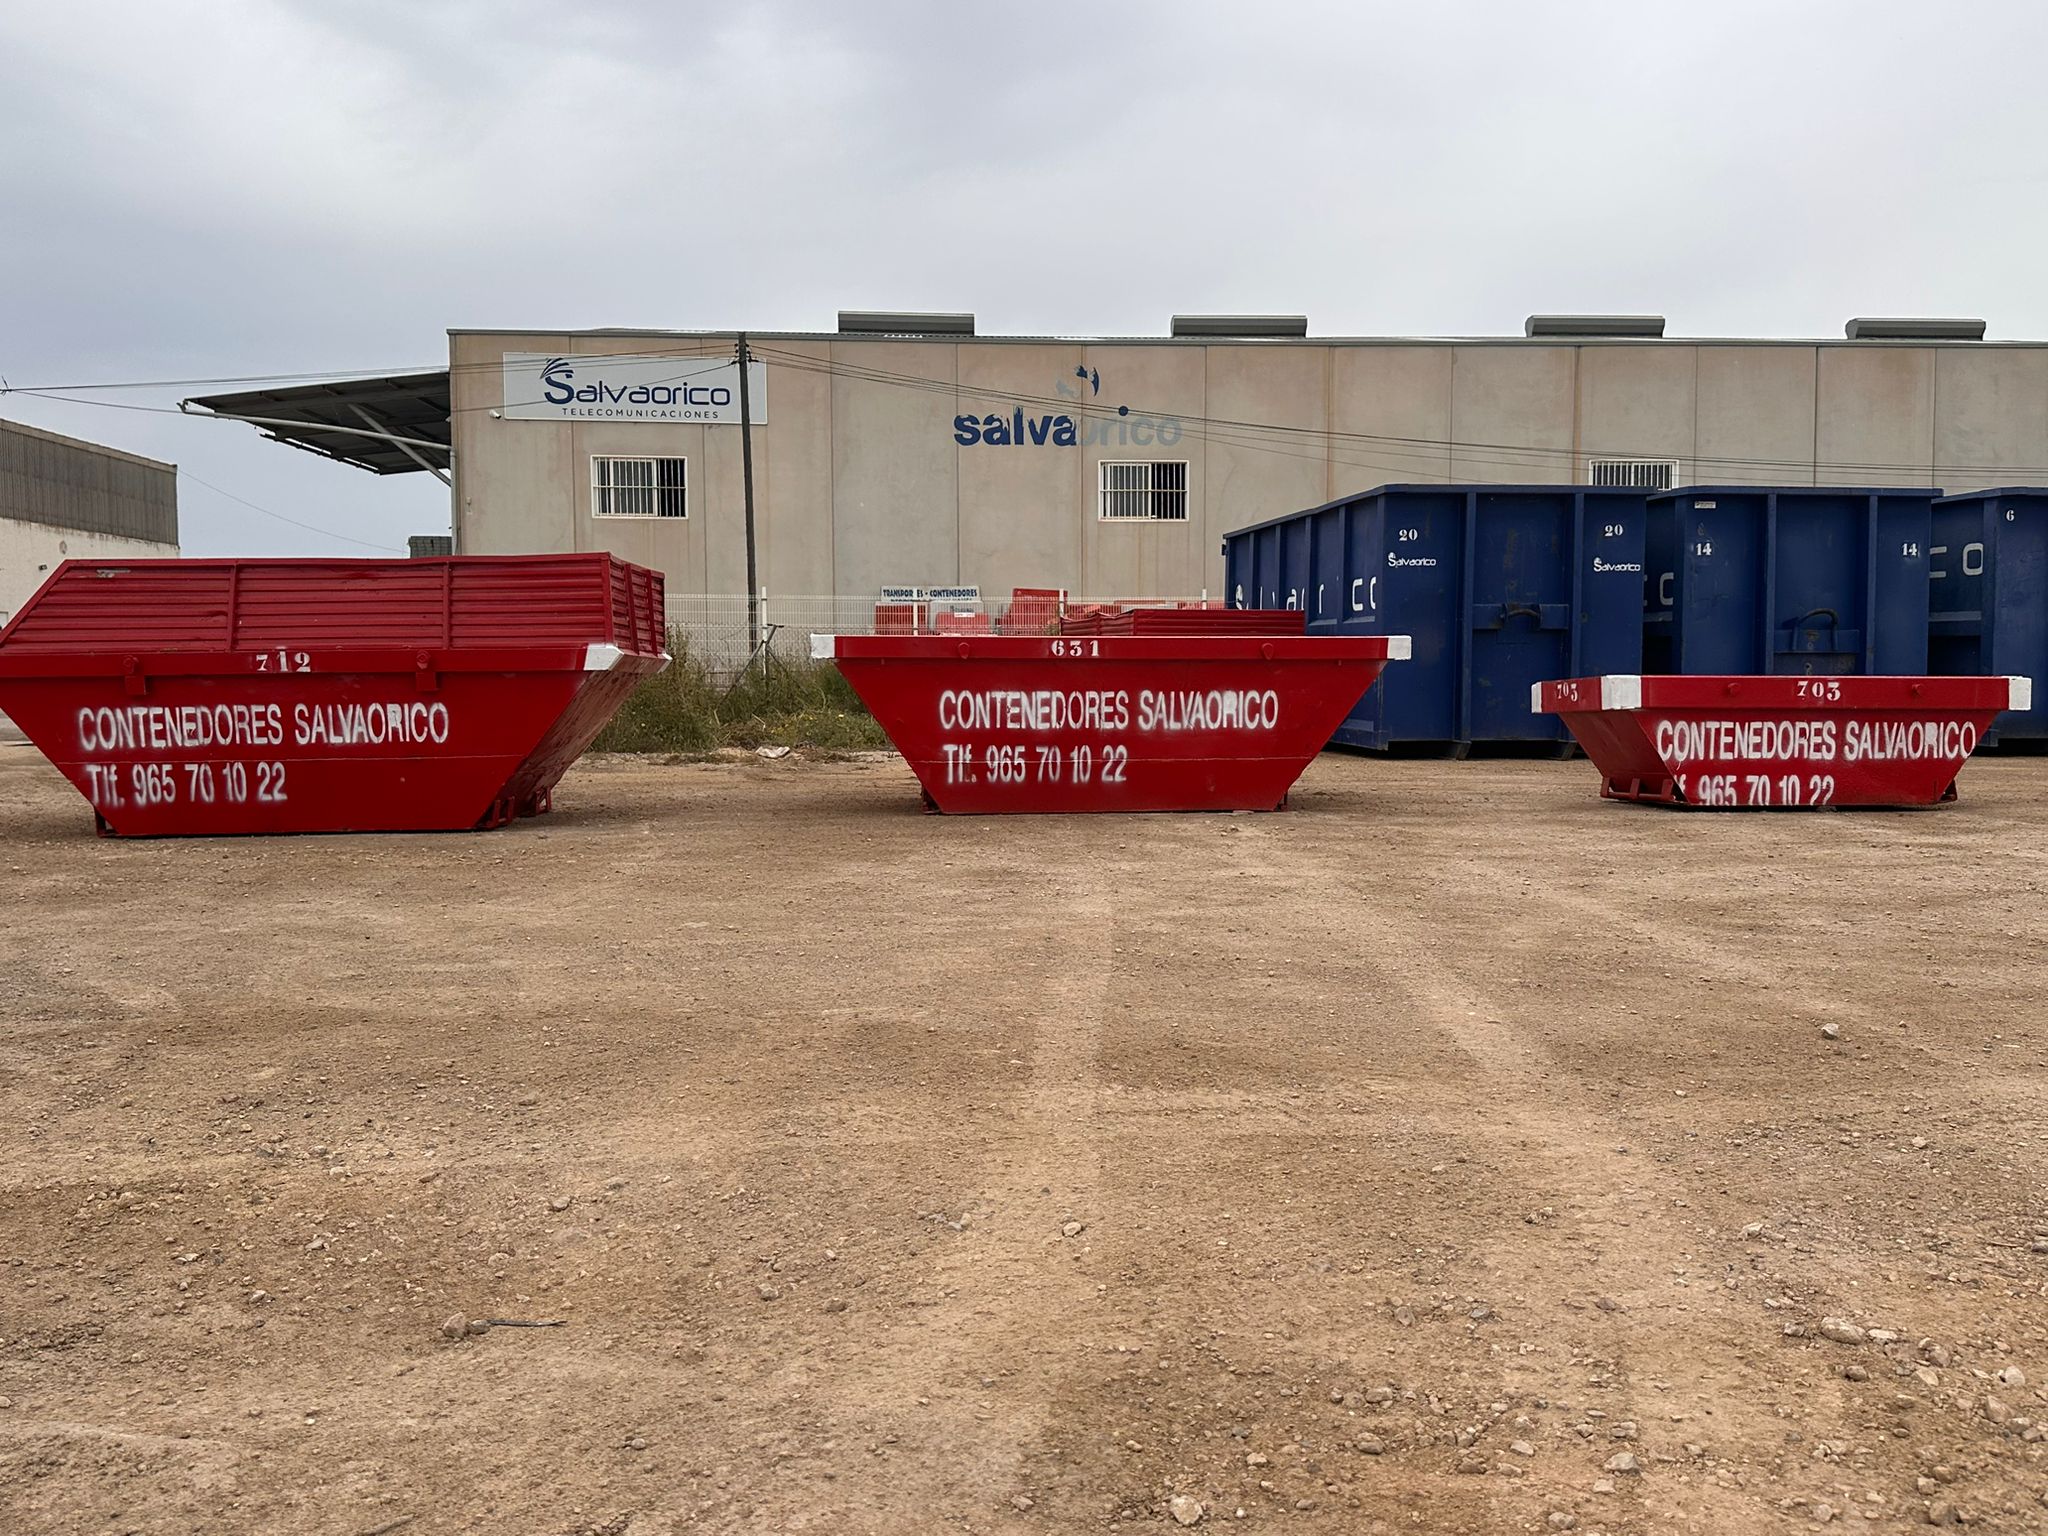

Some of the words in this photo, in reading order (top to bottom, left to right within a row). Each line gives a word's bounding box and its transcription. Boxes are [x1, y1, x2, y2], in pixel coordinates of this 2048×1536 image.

[543, 371, 731, 406] Salvaorico
[562, 407, 719, 419] TELECOMUNICACIONES
[2006, 510, 2015, 521] 6
[1399, 529, 1418, 541] 20
[1604, 524, 1624, 536] 20
[1695, 542, 1712, 556] 14
[1901, 543, 1917, 556] 14
[1388, 552, 1436, 567] Salvaorico
[1593, 557, 1641, 572] Salvaorico
[883, 589, 923, 598] TRANSPORES
[929, 588, 977, 597] CONTENEDORES
[1051, 639, 1099, 657] 631
[256, 646, 311, 673] 712
[1556, 682, 1579, 702] 703
[1797, 680, 1841, 701] 703
[938, 689, 1129, 730] CONTENEDORES
[1137, 689, 1279, 731] SALVAORICO
[78, 703, 284, 750] CONTENEDORES
[294, 702, 449, 745] SALVAORICO
[1656, 719, 1837, 762] CONTENEDORES
[1843, 720, 1977, 761] SALVAORICO
[942, 743, 977, 784] Tlf.
[985, 744, 1026, 783] 965
[1036, 745, 1061, 783] 70
[1069, 744, 1092, 784] 10
[1101, 744, 1128, 783] 22
[86, 763, 125, 807] Tlf.
[132, 763, 176, 806] 965
[185, 763, 215, 803] 70
[222, 761, 247, 803] 10
[256, 761, 288, 802] 22
[1698, 774, 1737, 806] 965
[1746, 775, 1770, 806] 70
[1779, 774, 1801, 806] 10
[1809, 775, 1834, 806] 22
